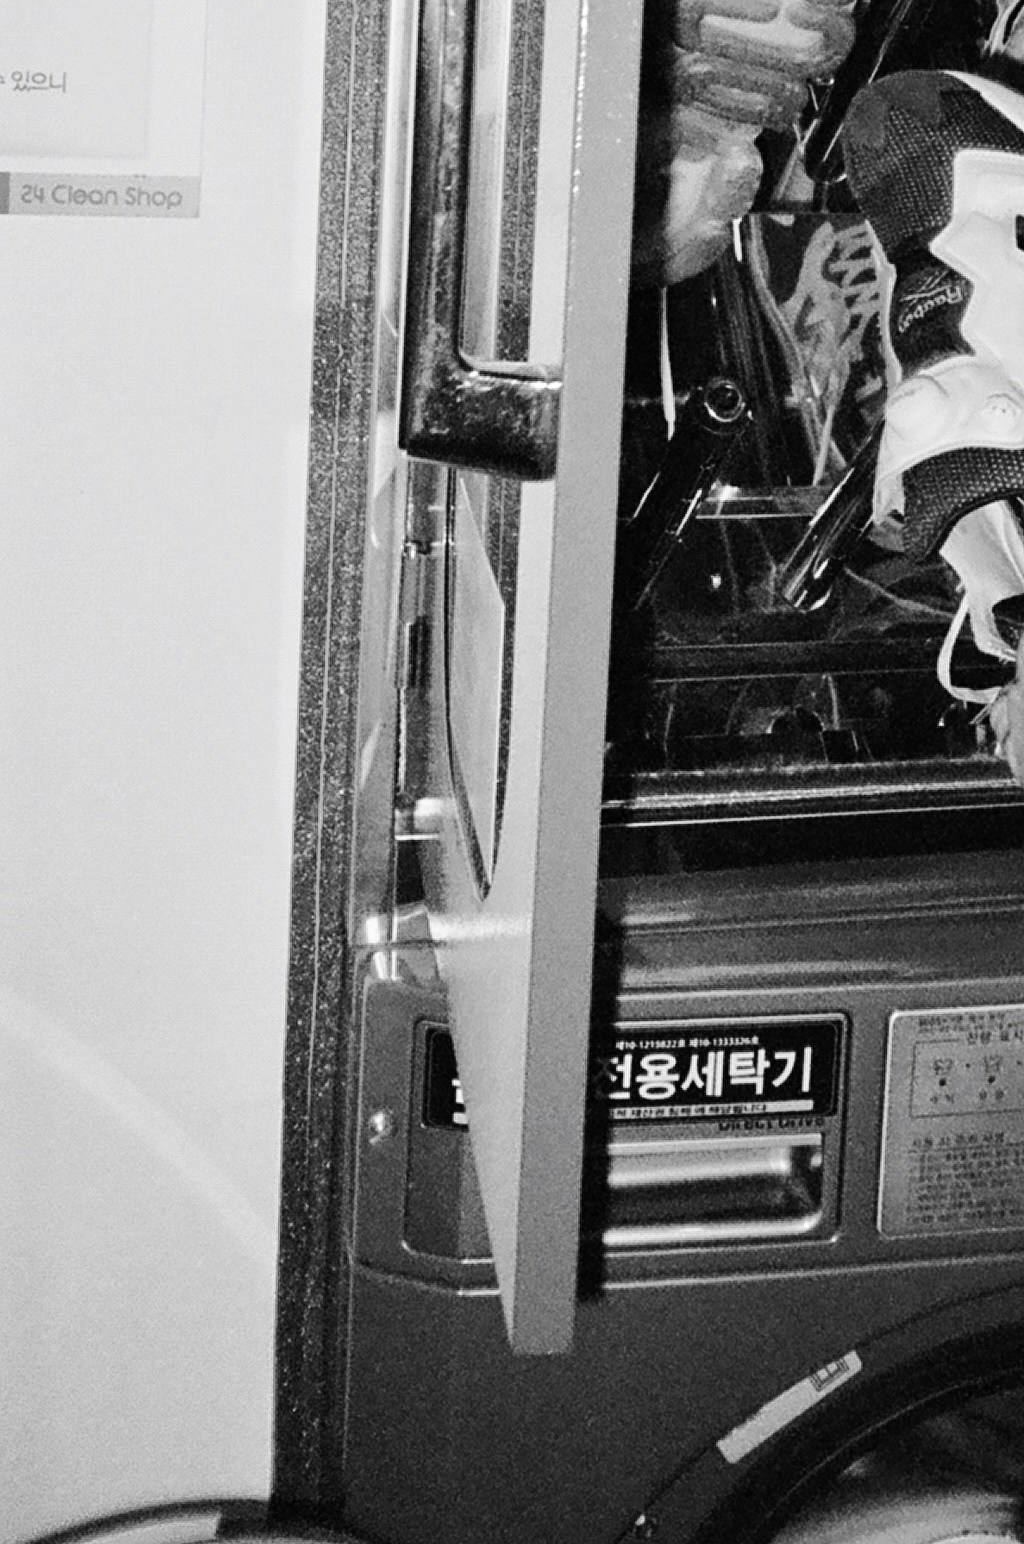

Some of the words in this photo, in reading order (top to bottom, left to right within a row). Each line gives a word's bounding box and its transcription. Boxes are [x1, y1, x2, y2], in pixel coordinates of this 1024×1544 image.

[11, 70, 67, 93] 있으니
[21, 183, 45, 205] 24
[51, 183, 118, 206] Clean
[124, 183, 183, 209] Shop
